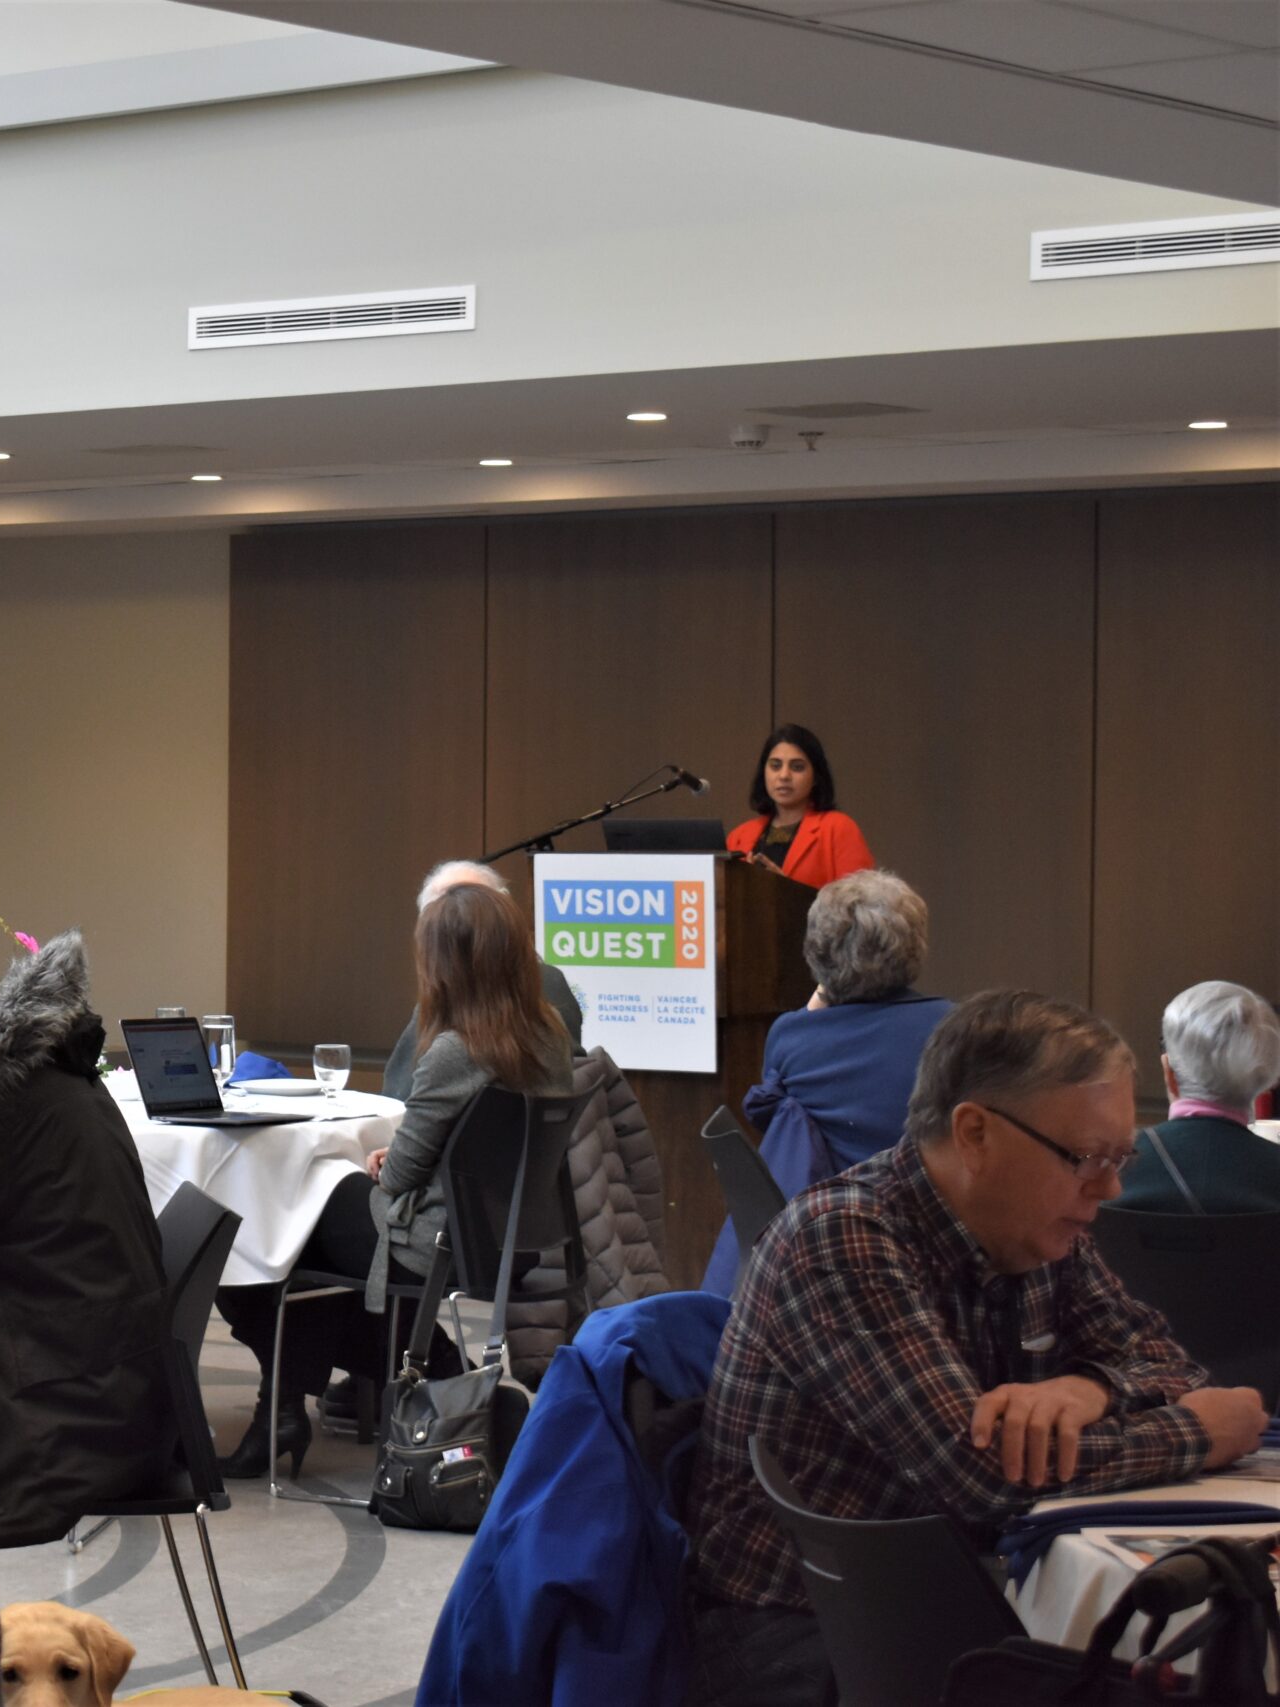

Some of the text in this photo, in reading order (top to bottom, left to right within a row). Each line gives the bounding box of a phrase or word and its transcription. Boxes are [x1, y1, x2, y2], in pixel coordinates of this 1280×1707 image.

[551, 888, 665, 916] VISION
[681, 889, 698, 960] 2020
[552, 930, 666, 960] QUEST
[598, 994, 640, 1002] FIGHTING
[657, 996, 697, 1004] VAINCRE
[598, 1004, 648, 1013] BLINDNESS
[657, 1006, 669, 1014] LA
[657, 1016, 695, 1024] CANADA
